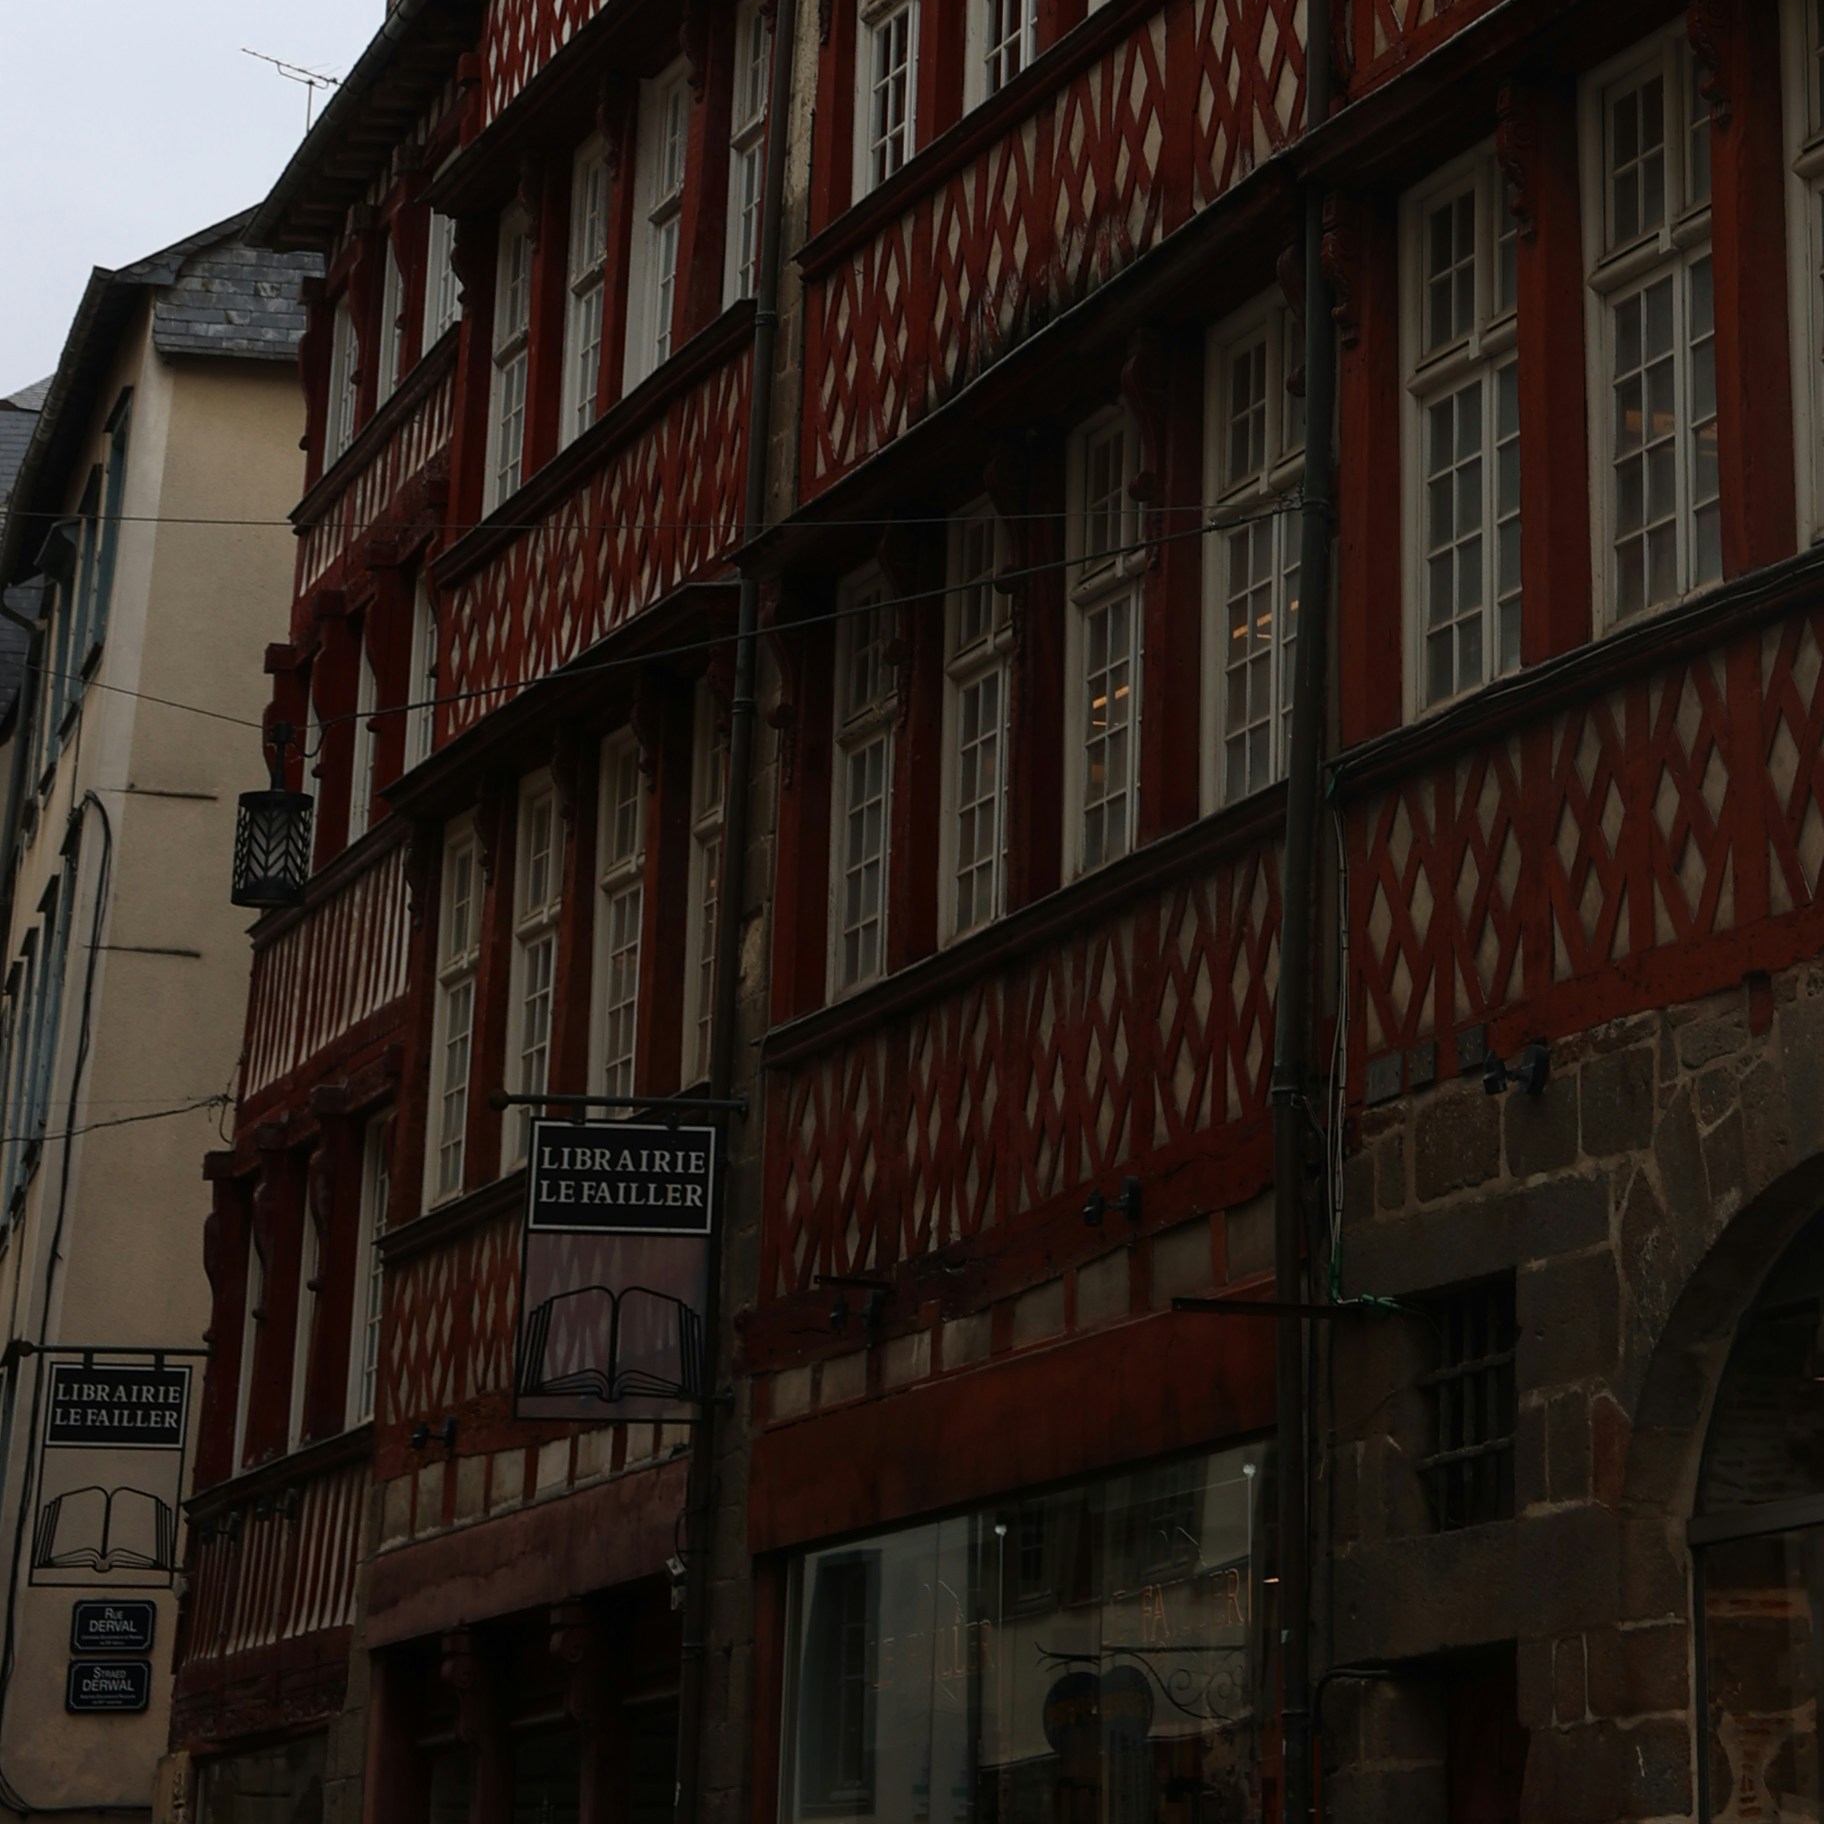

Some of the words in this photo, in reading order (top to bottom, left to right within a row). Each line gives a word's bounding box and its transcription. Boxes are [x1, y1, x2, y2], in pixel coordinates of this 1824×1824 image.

[540, 1146, 707, 1174] LIBRAIRIE
[538, 1179, 576, 1203] LE
[580, 1180, 704, 1208] FAILLER
[56, 1382, 182, 1404] LIBRAIRIE
[54, 1407, 82, 1426] LE
[84, 1407, 179, 1429] FAILLER
[1141, 1567, 1245, 1643] FAER
[88, 1619, 138, 1633] DERVAL
[81, 1679, 136, 1693] DERWAL
